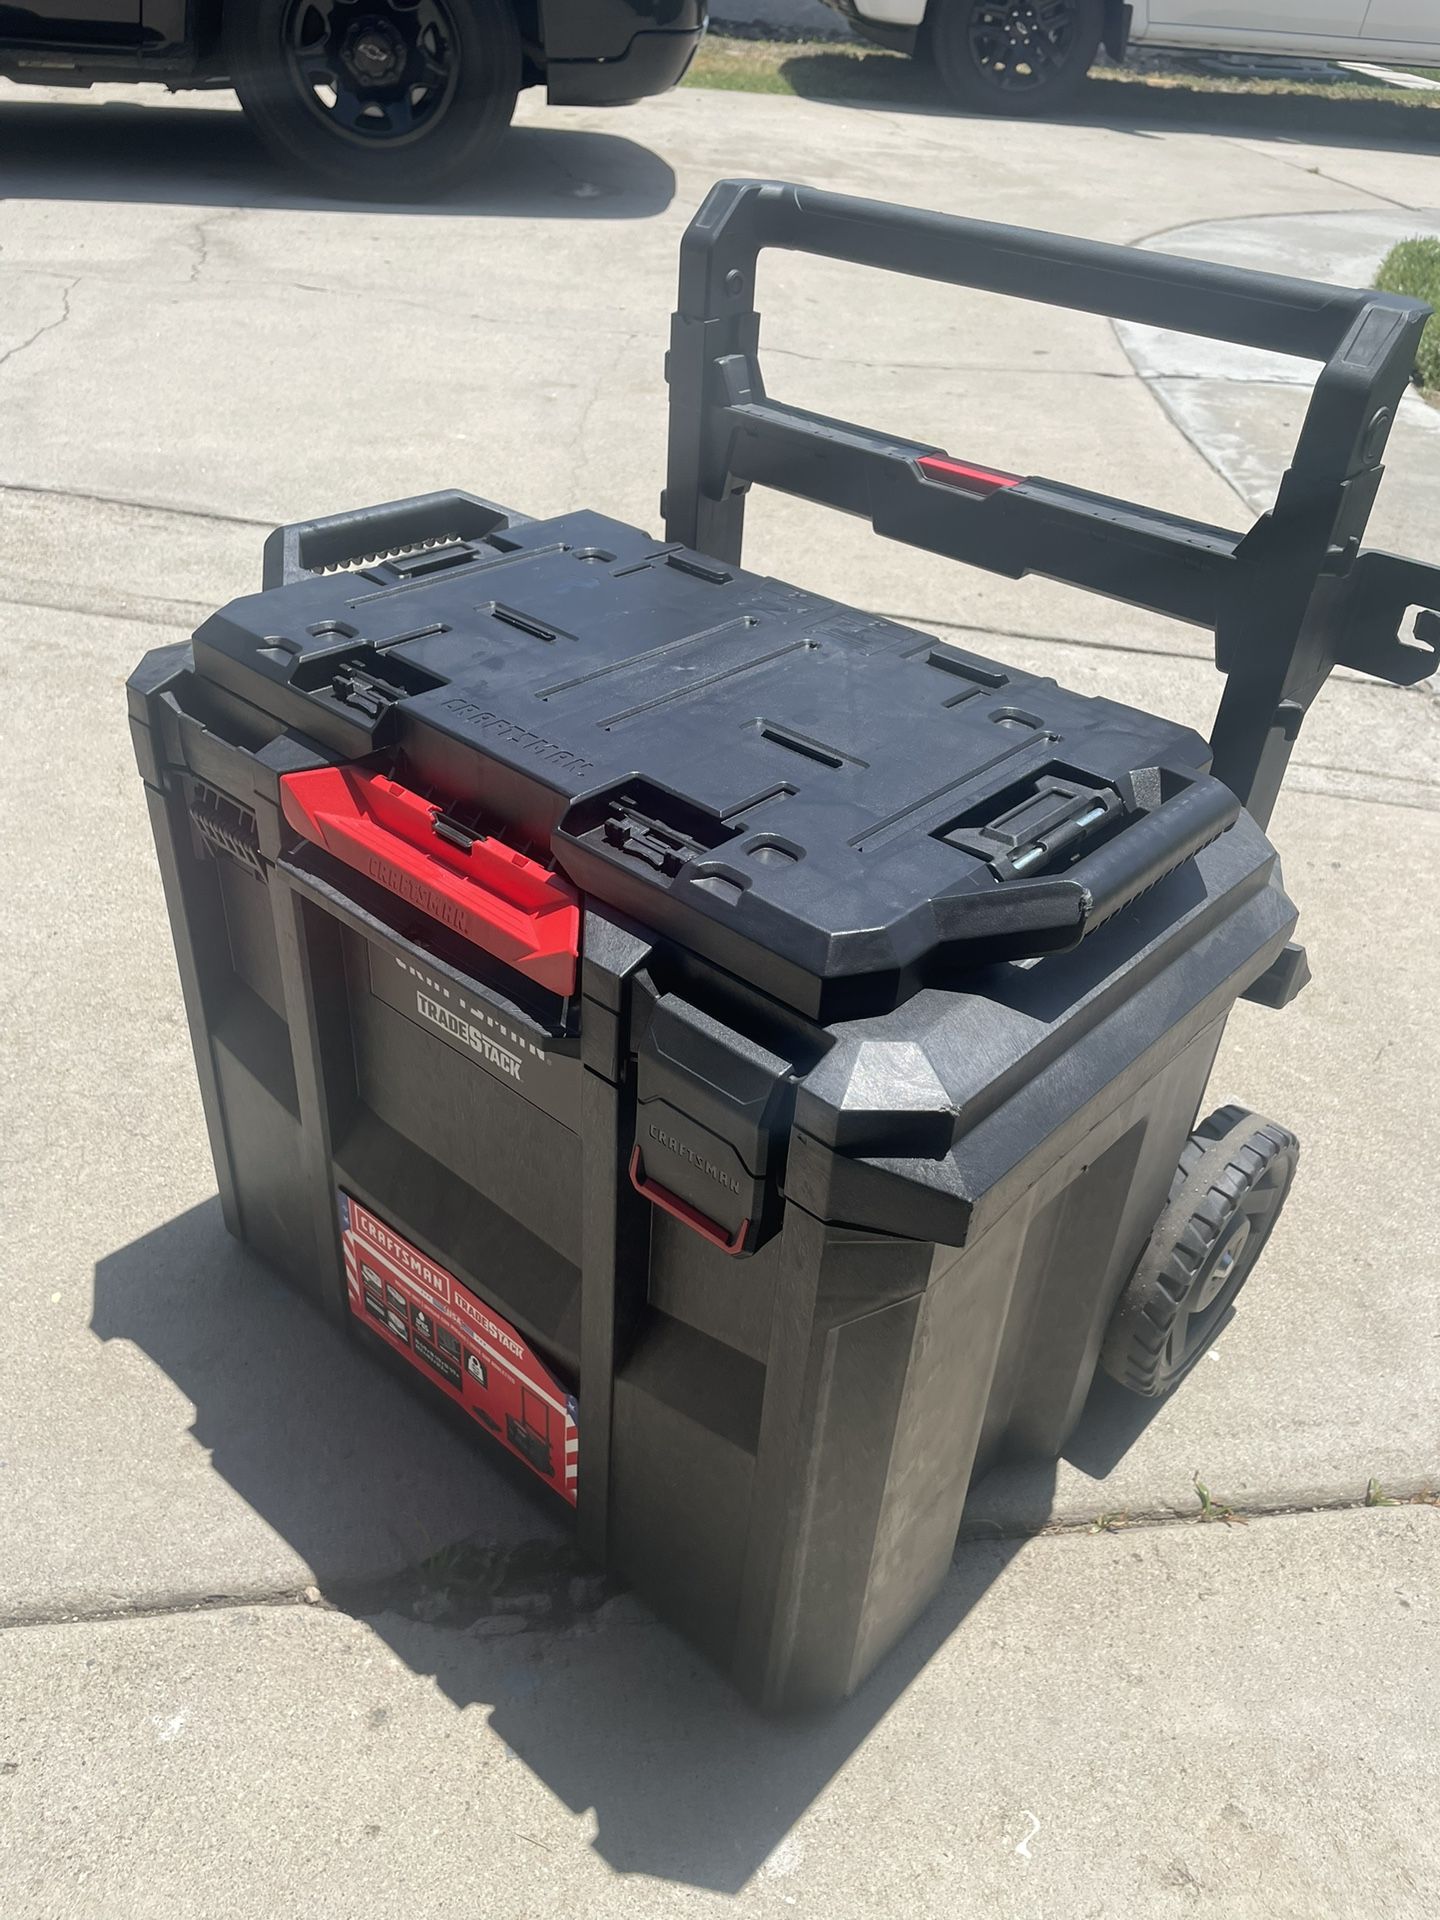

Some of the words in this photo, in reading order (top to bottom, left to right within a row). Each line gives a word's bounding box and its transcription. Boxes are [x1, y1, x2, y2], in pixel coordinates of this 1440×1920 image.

[440, 698, 594, 777] CRAFTSMAN
[368, 857, 467, 933] CRAFTSMAN
[648, 1123, 741, 1195] CRAFTSMAN
[360, 1215, 443, 1292] CRAFTSMAN
